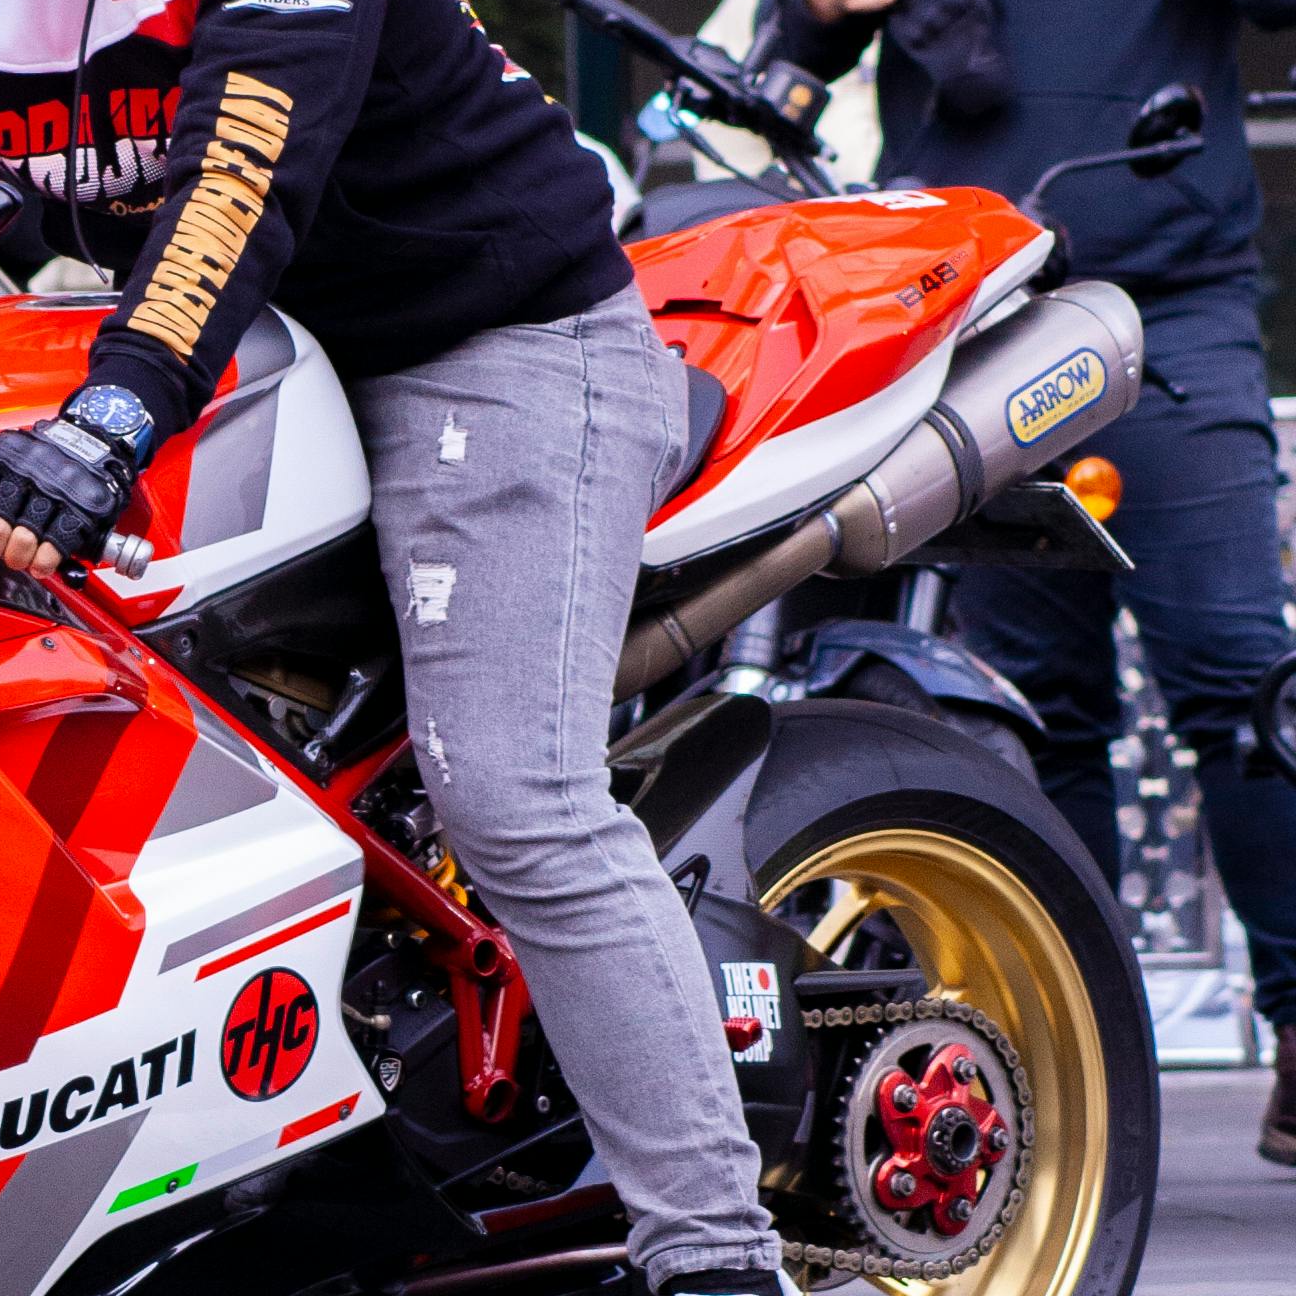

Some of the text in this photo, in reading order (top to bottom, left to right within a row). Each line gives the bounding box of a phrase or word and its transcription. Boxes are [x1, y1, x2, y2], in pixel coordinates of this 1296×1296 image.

[215, 71, 294, 164] DAY
[895, 261, 960, 309] 848
[1018, 356, 1091, 428] ARROW
[719, 962, 753, 996] THE
[226, 970, 318, 1095] THC
